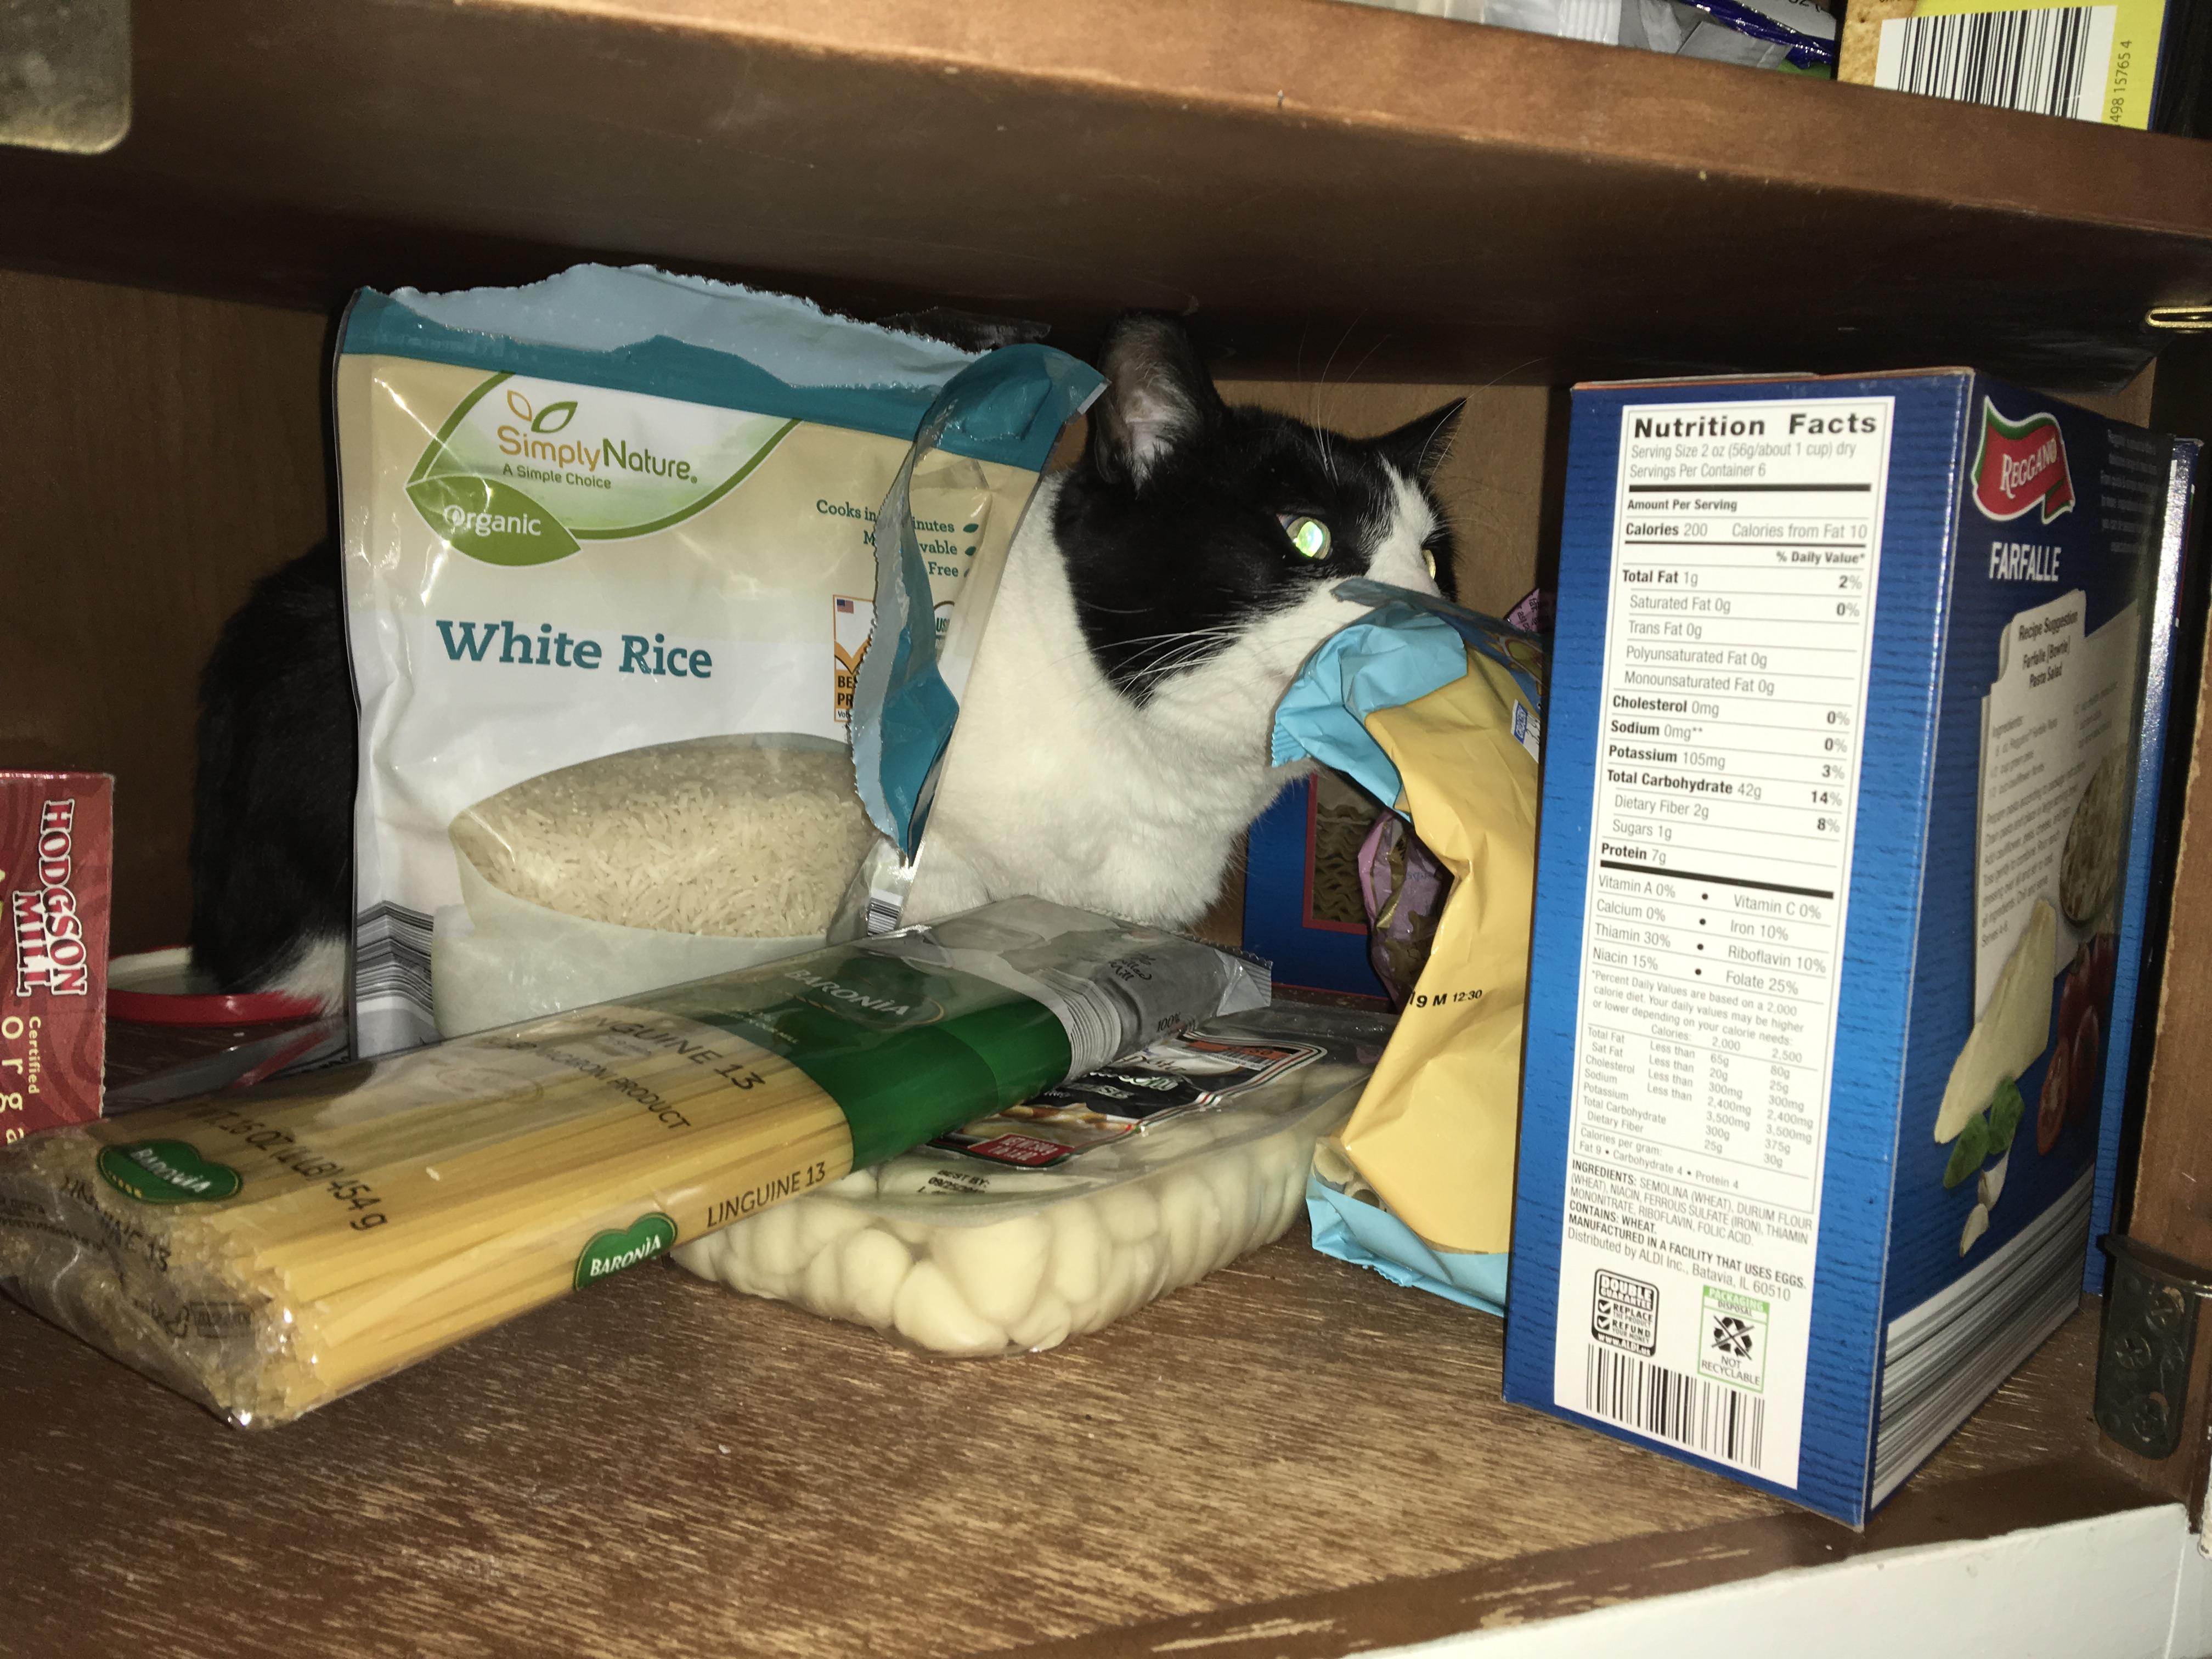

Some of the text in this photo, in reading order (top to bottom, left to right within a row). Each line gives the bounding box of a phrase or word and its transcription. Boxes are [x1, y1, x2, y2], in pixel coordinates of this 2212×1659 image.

[2120, 40, 2132, 48] 4
[2113, 52, 2131, 92] 15765
[1634, 413, 1877, 438] Nutrition Facts
[1632, 444, 1672, 461] Serving
[1675, 444, 1699, 457] Size
[1702, 444, 1708, 456] 2
[1712, 446, 1724, 456] oz
[1797, 443, 1802, 456] 1
[1807, 442, 1832, 458] cup)
[1837, 442, 1856, 459] dry
[503, 464, 612, 490] A Simple Choice
[1630, 462, 1765, 479] Servings Per Container 6
[816, 499, 861, 519] Cooks
[1627, 499, 1737, 512] Amount Per Serving
[443, 504, 541, 537] Organic
[1626, 523, 1867, 539] Calories 200 Calories from Fat 10
[928, 561, 958, 577] Free
[1791, 551, 1821, 565] Daily
[1989, 540, 2062, 582] FARFALLE
[1623, 569, 1863, 590] Total Fat 1g 2%
[1630, 595, 1860, 617] Saturated Fat 0g 0%
[436, 619, 712, 679] White Rice
[1626, 645, 1767, 669] Polyunsaturated Fat 0g
[1624, 670, 1775, 696] Monounsaturated Fat 0g
[1612, 695, 1850, 726] Cholesterol 0mg 0%
[1610, 720, 1660, 736] Sodium
[1824, 737, 1848, 753] 0%
[1609, 744, 1845, 780] Potassium 105mg 3%
[1607, 769, 1843, 807] Total Carbohydrate 42g 14%
[1615, 794, 1840, 833] Dietary Fiber 2g 8%
[1612, 820, 1672, 841] Sugars 1g
[1601, 843, 1667, 865] Protein 7g
[38, 798, 88, 996] HODGSON
[1598, 874, 1676, 899] Vitamin A 0%
[1596, 899, 1666, 922] Calcium 0%
[1734, 893, 1821, 920] Vitamin C 0%
[12, 890, 52, 997] MILL
[1594, 922, 1671, 949] Thiamin 30%
[1730, 919, 1789, 942] Iron 10%
[1593, 946, 1659, 971] Niacin 15%
[1728, 945, 1826, 974] Riboflavin 10%
[1726, 970, 1799, 996] Folate 25%
[28, 1015, 41, 1095] Certified
[716, 1059, 766, 1092] 13
[608, 1069, 692, 1130] PRODUCT
[327, 1180, 382, 1210] 454
[706, 1160, 827, 1228] LINGUINE 13
[1572, 1159, 1637, 1187] INGREDIENTS:
[1639, 1177, 1689, 1200] SEMOLINA
[1736, 1201, 1775, 1222] DURUM
[1778, 1211, 1812, 1231] FLOUR
[349, 1212, 388, 1230] g
[1569, 1201, 1657, 1235] CONTAINS: WHEAT.
[1568, 1214, 1807, 1290] MANUFACTURED IN A FACILITY THAT USES EGGS.
[1568, 1226, 1622, 1254] Distributed
[1624, 1243, 1637, 1259] by
[1639, 1248, 1663, 1267] ALDI
[1691, 1261, 1736, 1288] Batavia,
[1740, 1275, 1751, 1290] IL
[1752, 1278, 1791, 1302] 60510
[1601, 1275, 1652, 1300] DOUBLE
[1613, 1304, 1653, 1322] REPLACE
[1612, 1319, 1651, 1338] REFUND
[1701, 1359, 1760, 1386] RECYCLABLE
[1721, 1355, 1741, 1369] NOT
